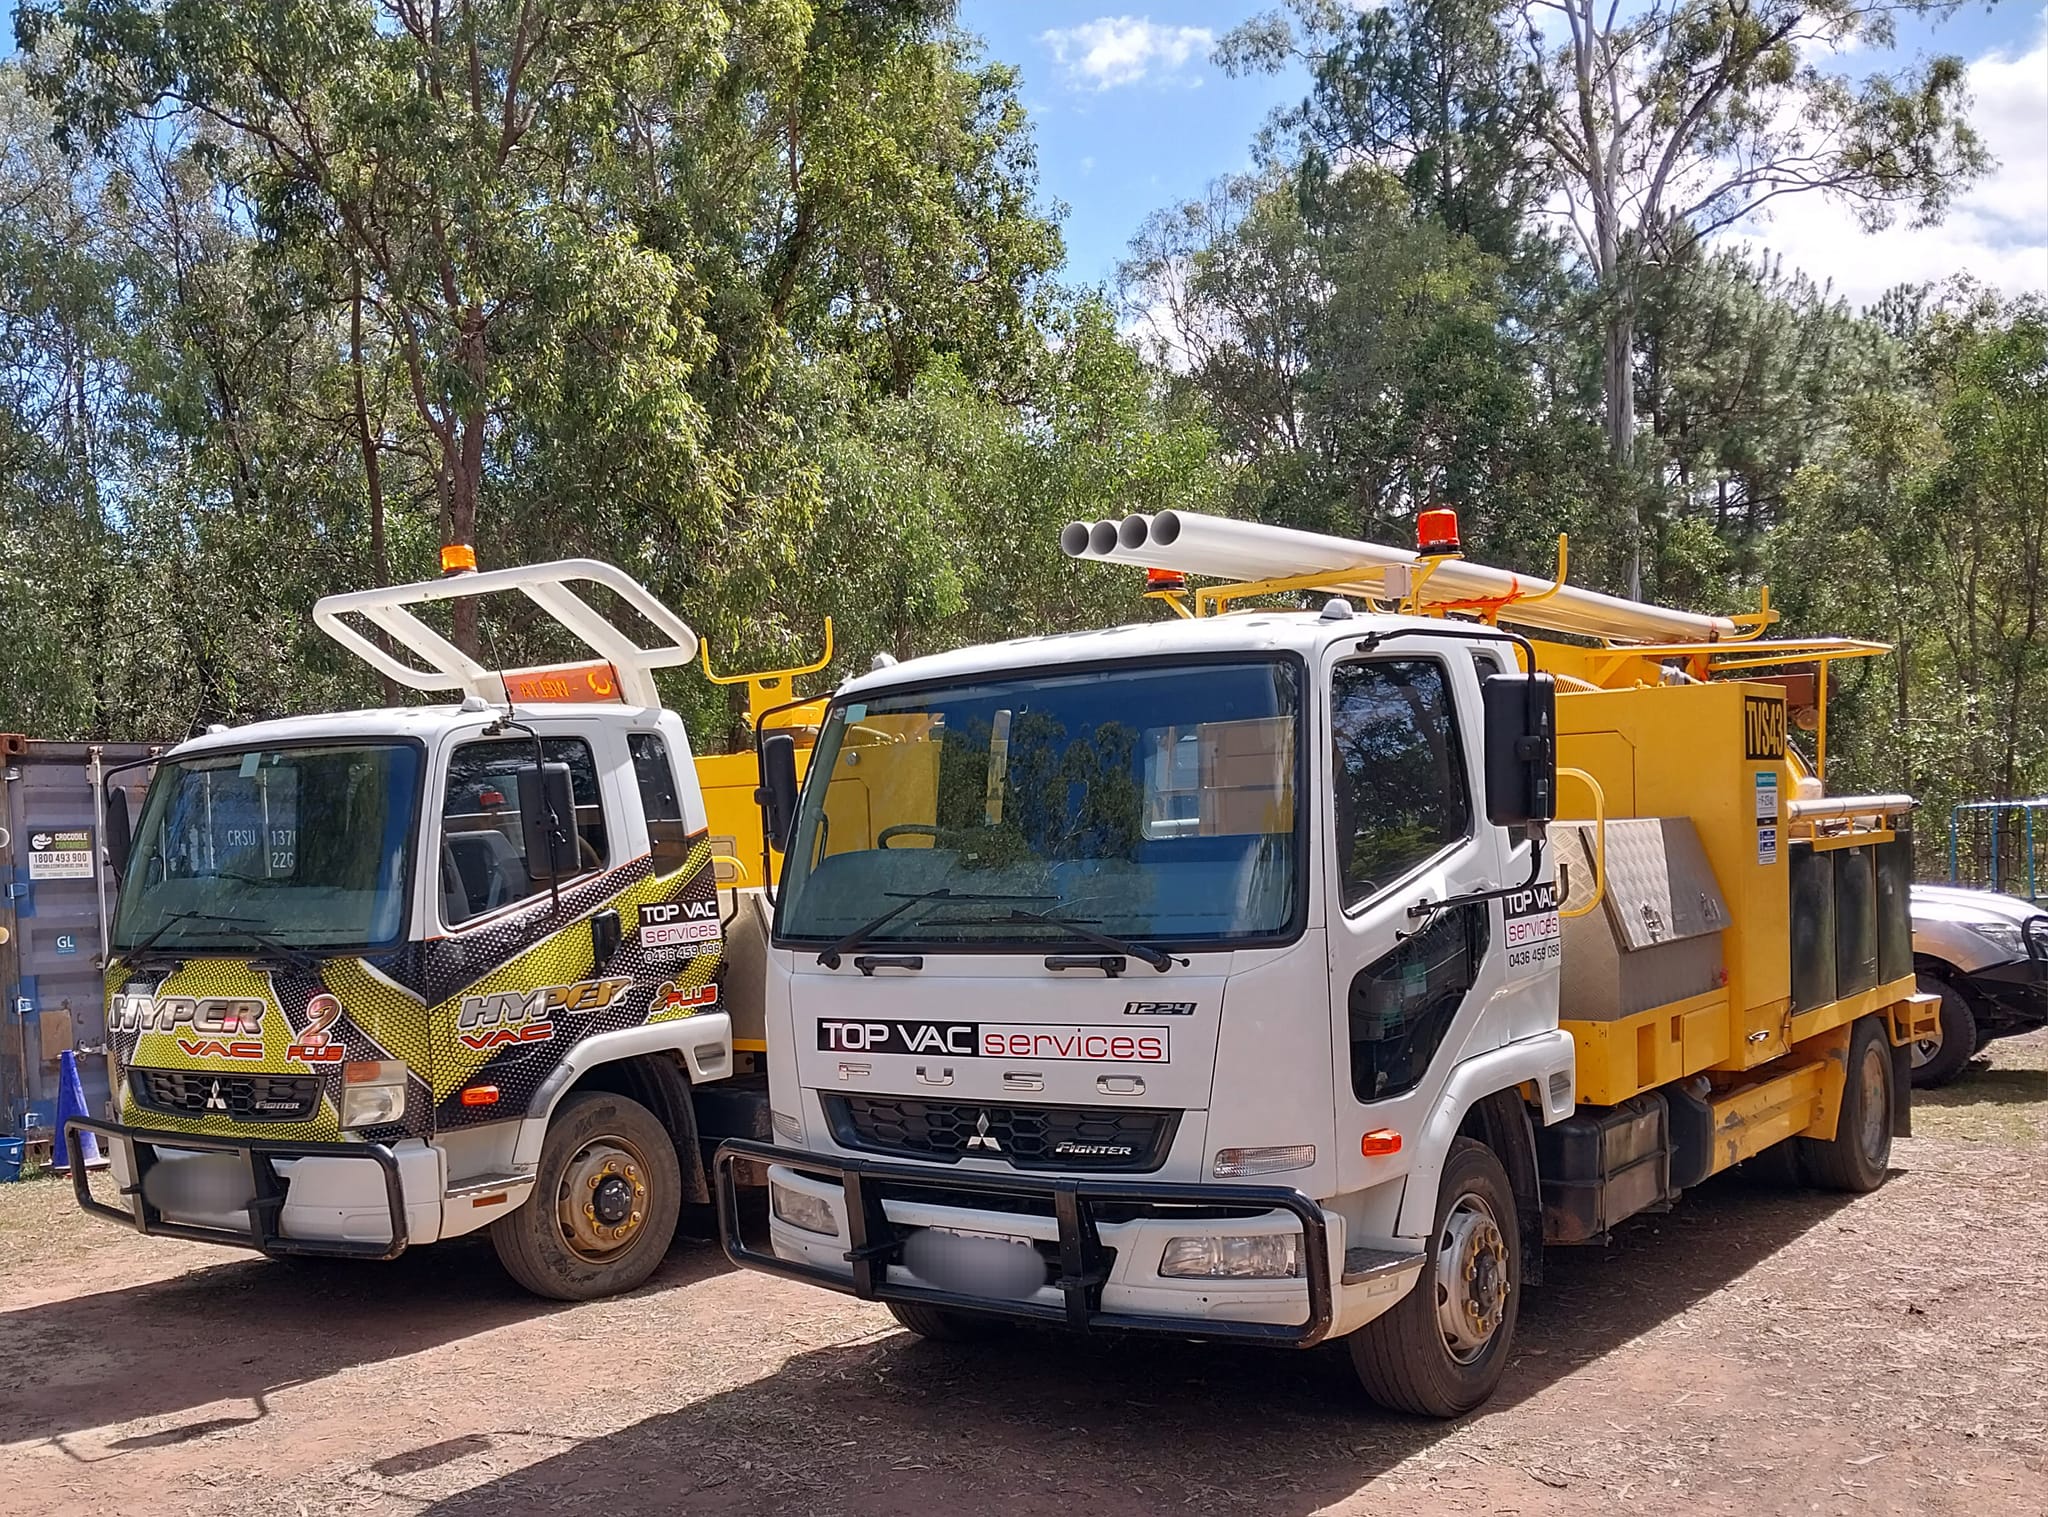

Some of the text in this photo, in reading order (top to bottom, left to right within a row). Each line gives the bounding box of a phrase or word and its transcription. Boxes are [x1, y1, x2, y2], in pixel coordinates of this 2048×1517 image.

[1746, 701, 1783, 755] TVS43
[227, 829, 256, 846] CRSU
[33, 852, 87, 863] 1800 493 900
[641, 900, 717, 923] TOP VAC
[1506, 886, 1558, 914] TOP VAC
[645, 923, 718, 944] services
[1508, 917, 1557, 942] services
[57, 935, 75, 948] GL
[645, 943, 720, 963] 0436 459 098
[1509, 951, 1530, 967] 0436
[1532, 947, 1546, 961] 459
[458, 976, 633, 1029] HYPER
[666, 984, 718, 1009] PLUS
[109, 995, 265, 1036] HYPER
[1127, 1002, 1193, 1015] 1224
[297, 996, 342, 1048] 2
[459, 1022, 554, 1050] VAC
[822, 1022, 1163, 1061] TOP VAC services
[177, 1039, 264, 1059] VAC
[286, 1044, 346, 1062] PLUS
[838, 1062, 1147, 1096] FUSO
[1055, 1141, 1132, 1156] FIGHTER
